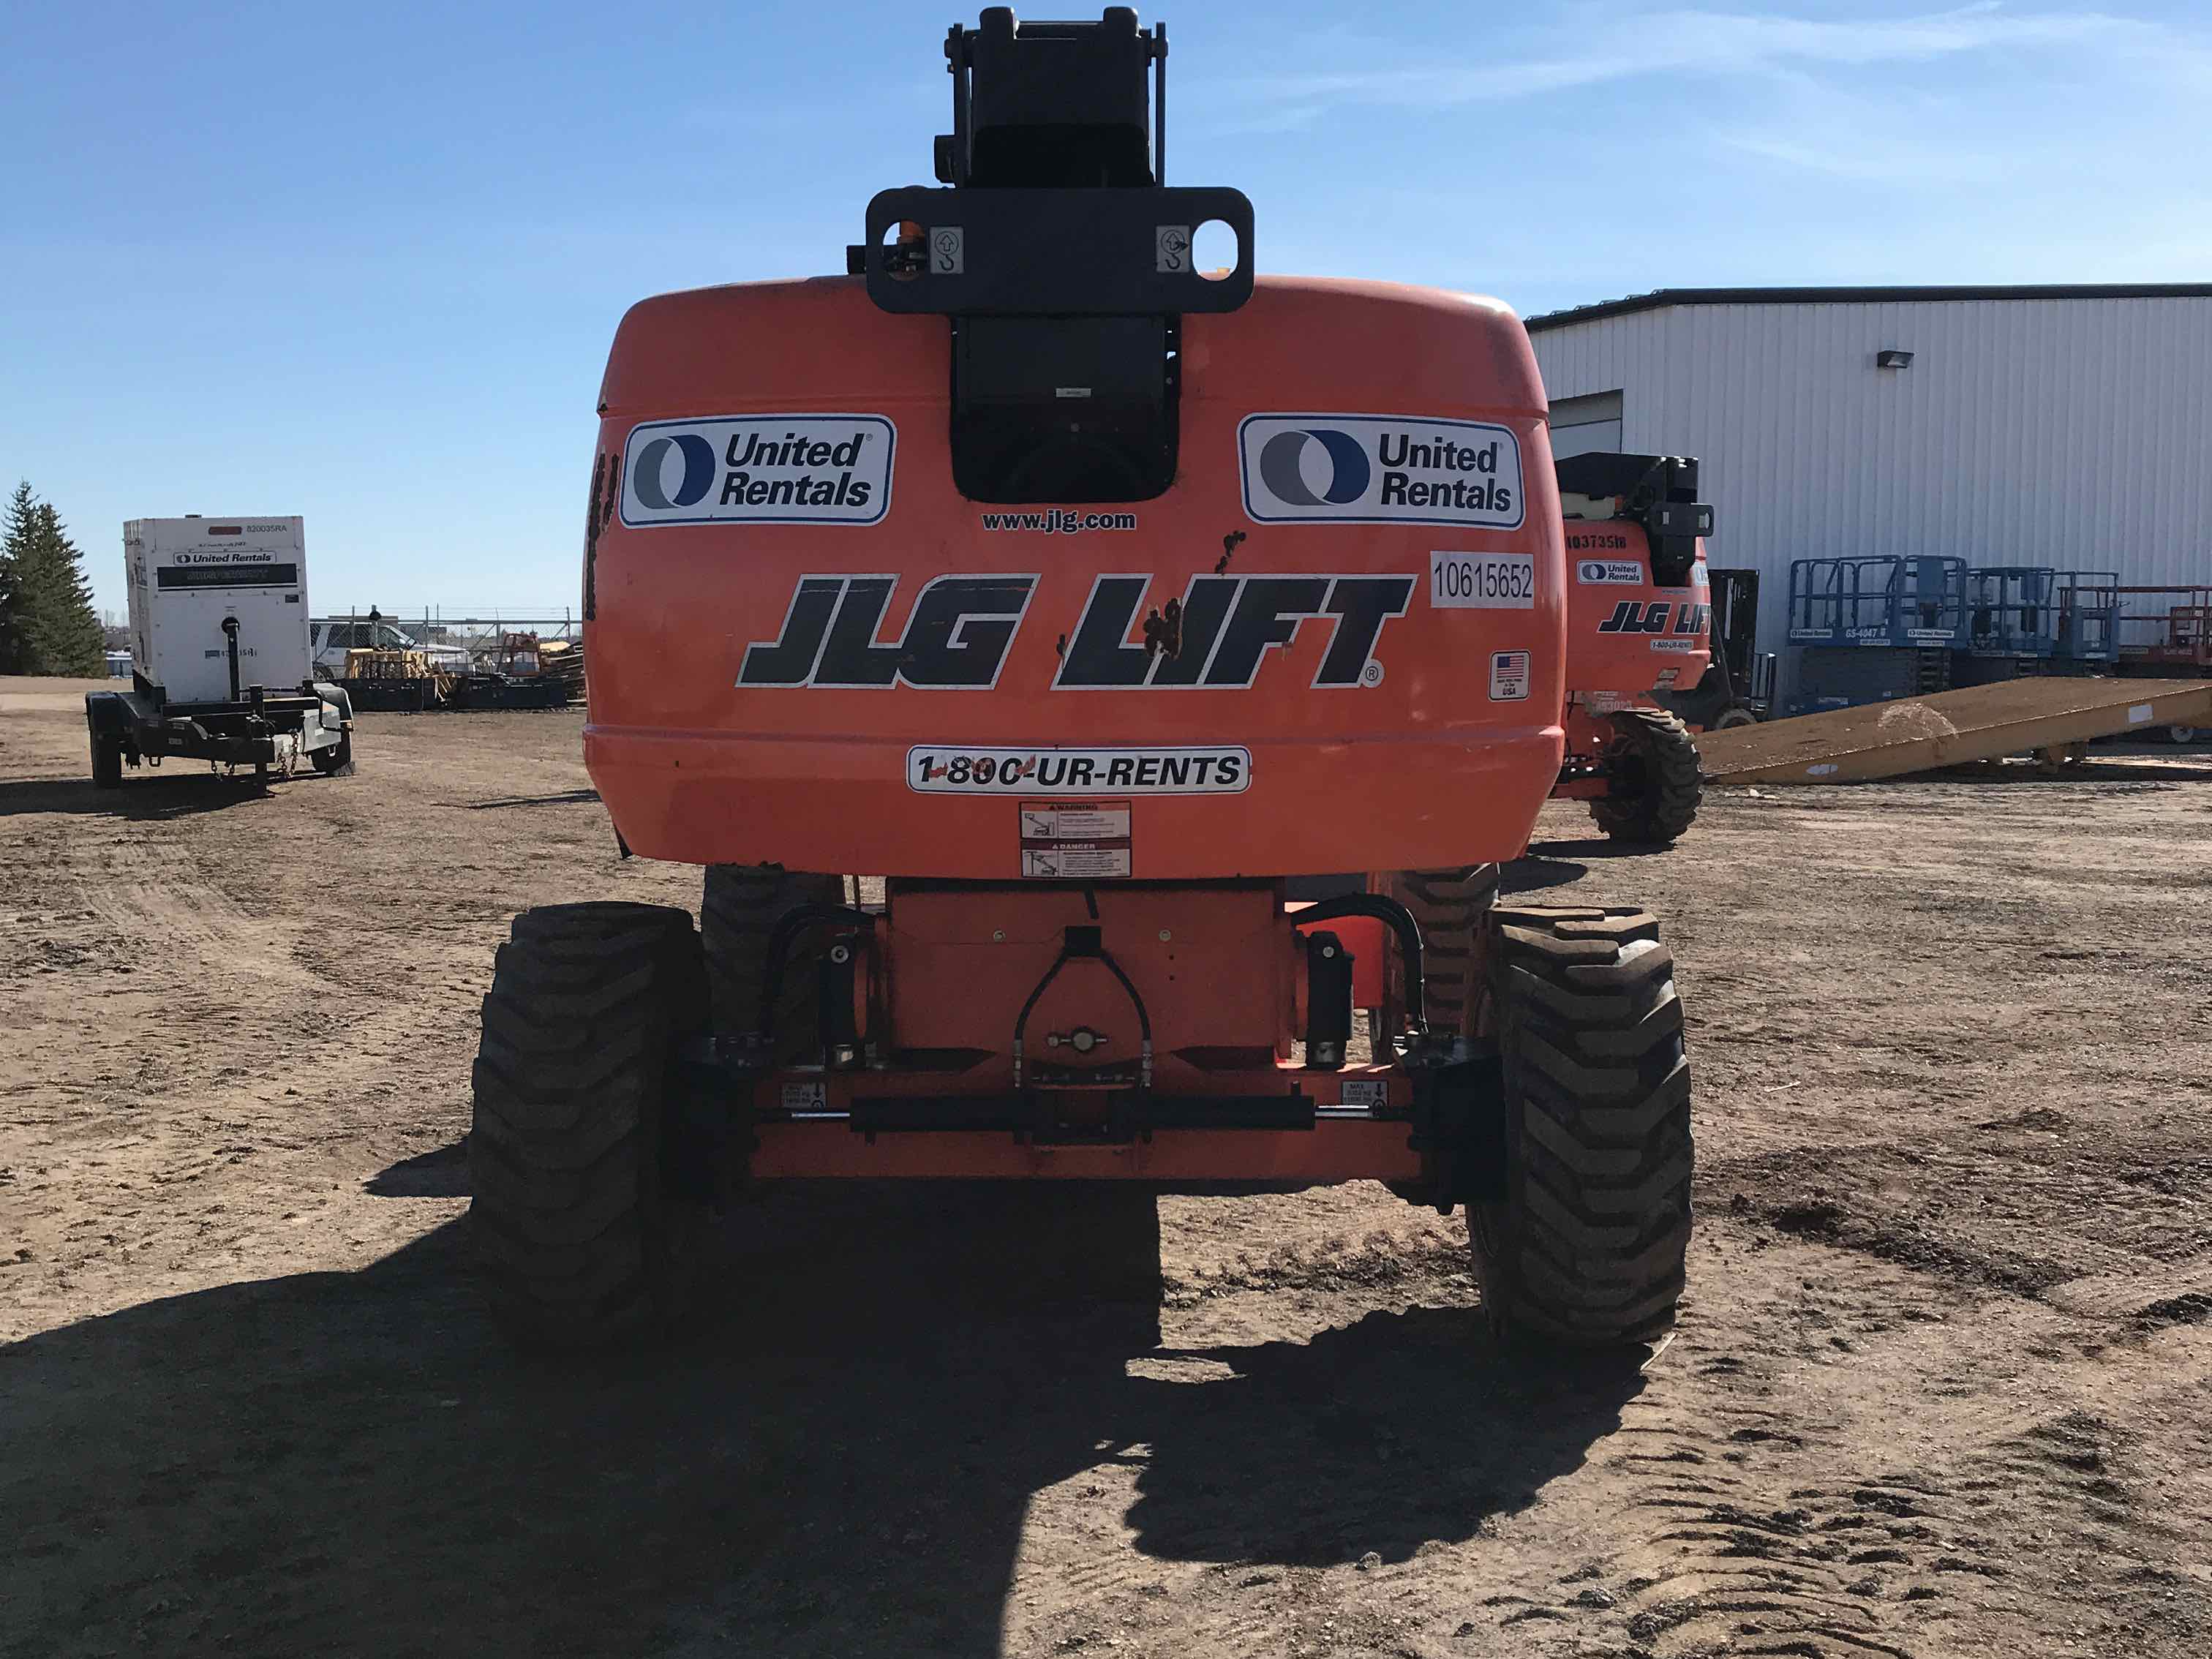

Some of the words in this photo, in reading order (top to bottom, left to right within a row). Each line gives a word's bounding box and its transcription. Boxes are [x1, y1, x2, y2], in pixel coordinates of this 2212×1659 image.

[726, 432, 865, 467] United
[1379, 433, 1498, 473] United
[719, 472, 871, 506] Rentals
[1380, 471, 1511, 512] Rentals
[982, 509, 1136, 534] www.jlg.com
[193, 554, 230, 563] United
[232, 553, 271, 563] Rentals
[1608, 564, 1637, 573] United
[1434, 562, 1532, 598] 10615652
[1608, 573, 1640, 581] Rentals
[734, 573, 1042, 690] JLG
[1049, 573, 1418, 690] LIFT
[1598, 601, 1672, 634] JLG
[917, 756, 1241, 786] 1800-UR-RENTS
